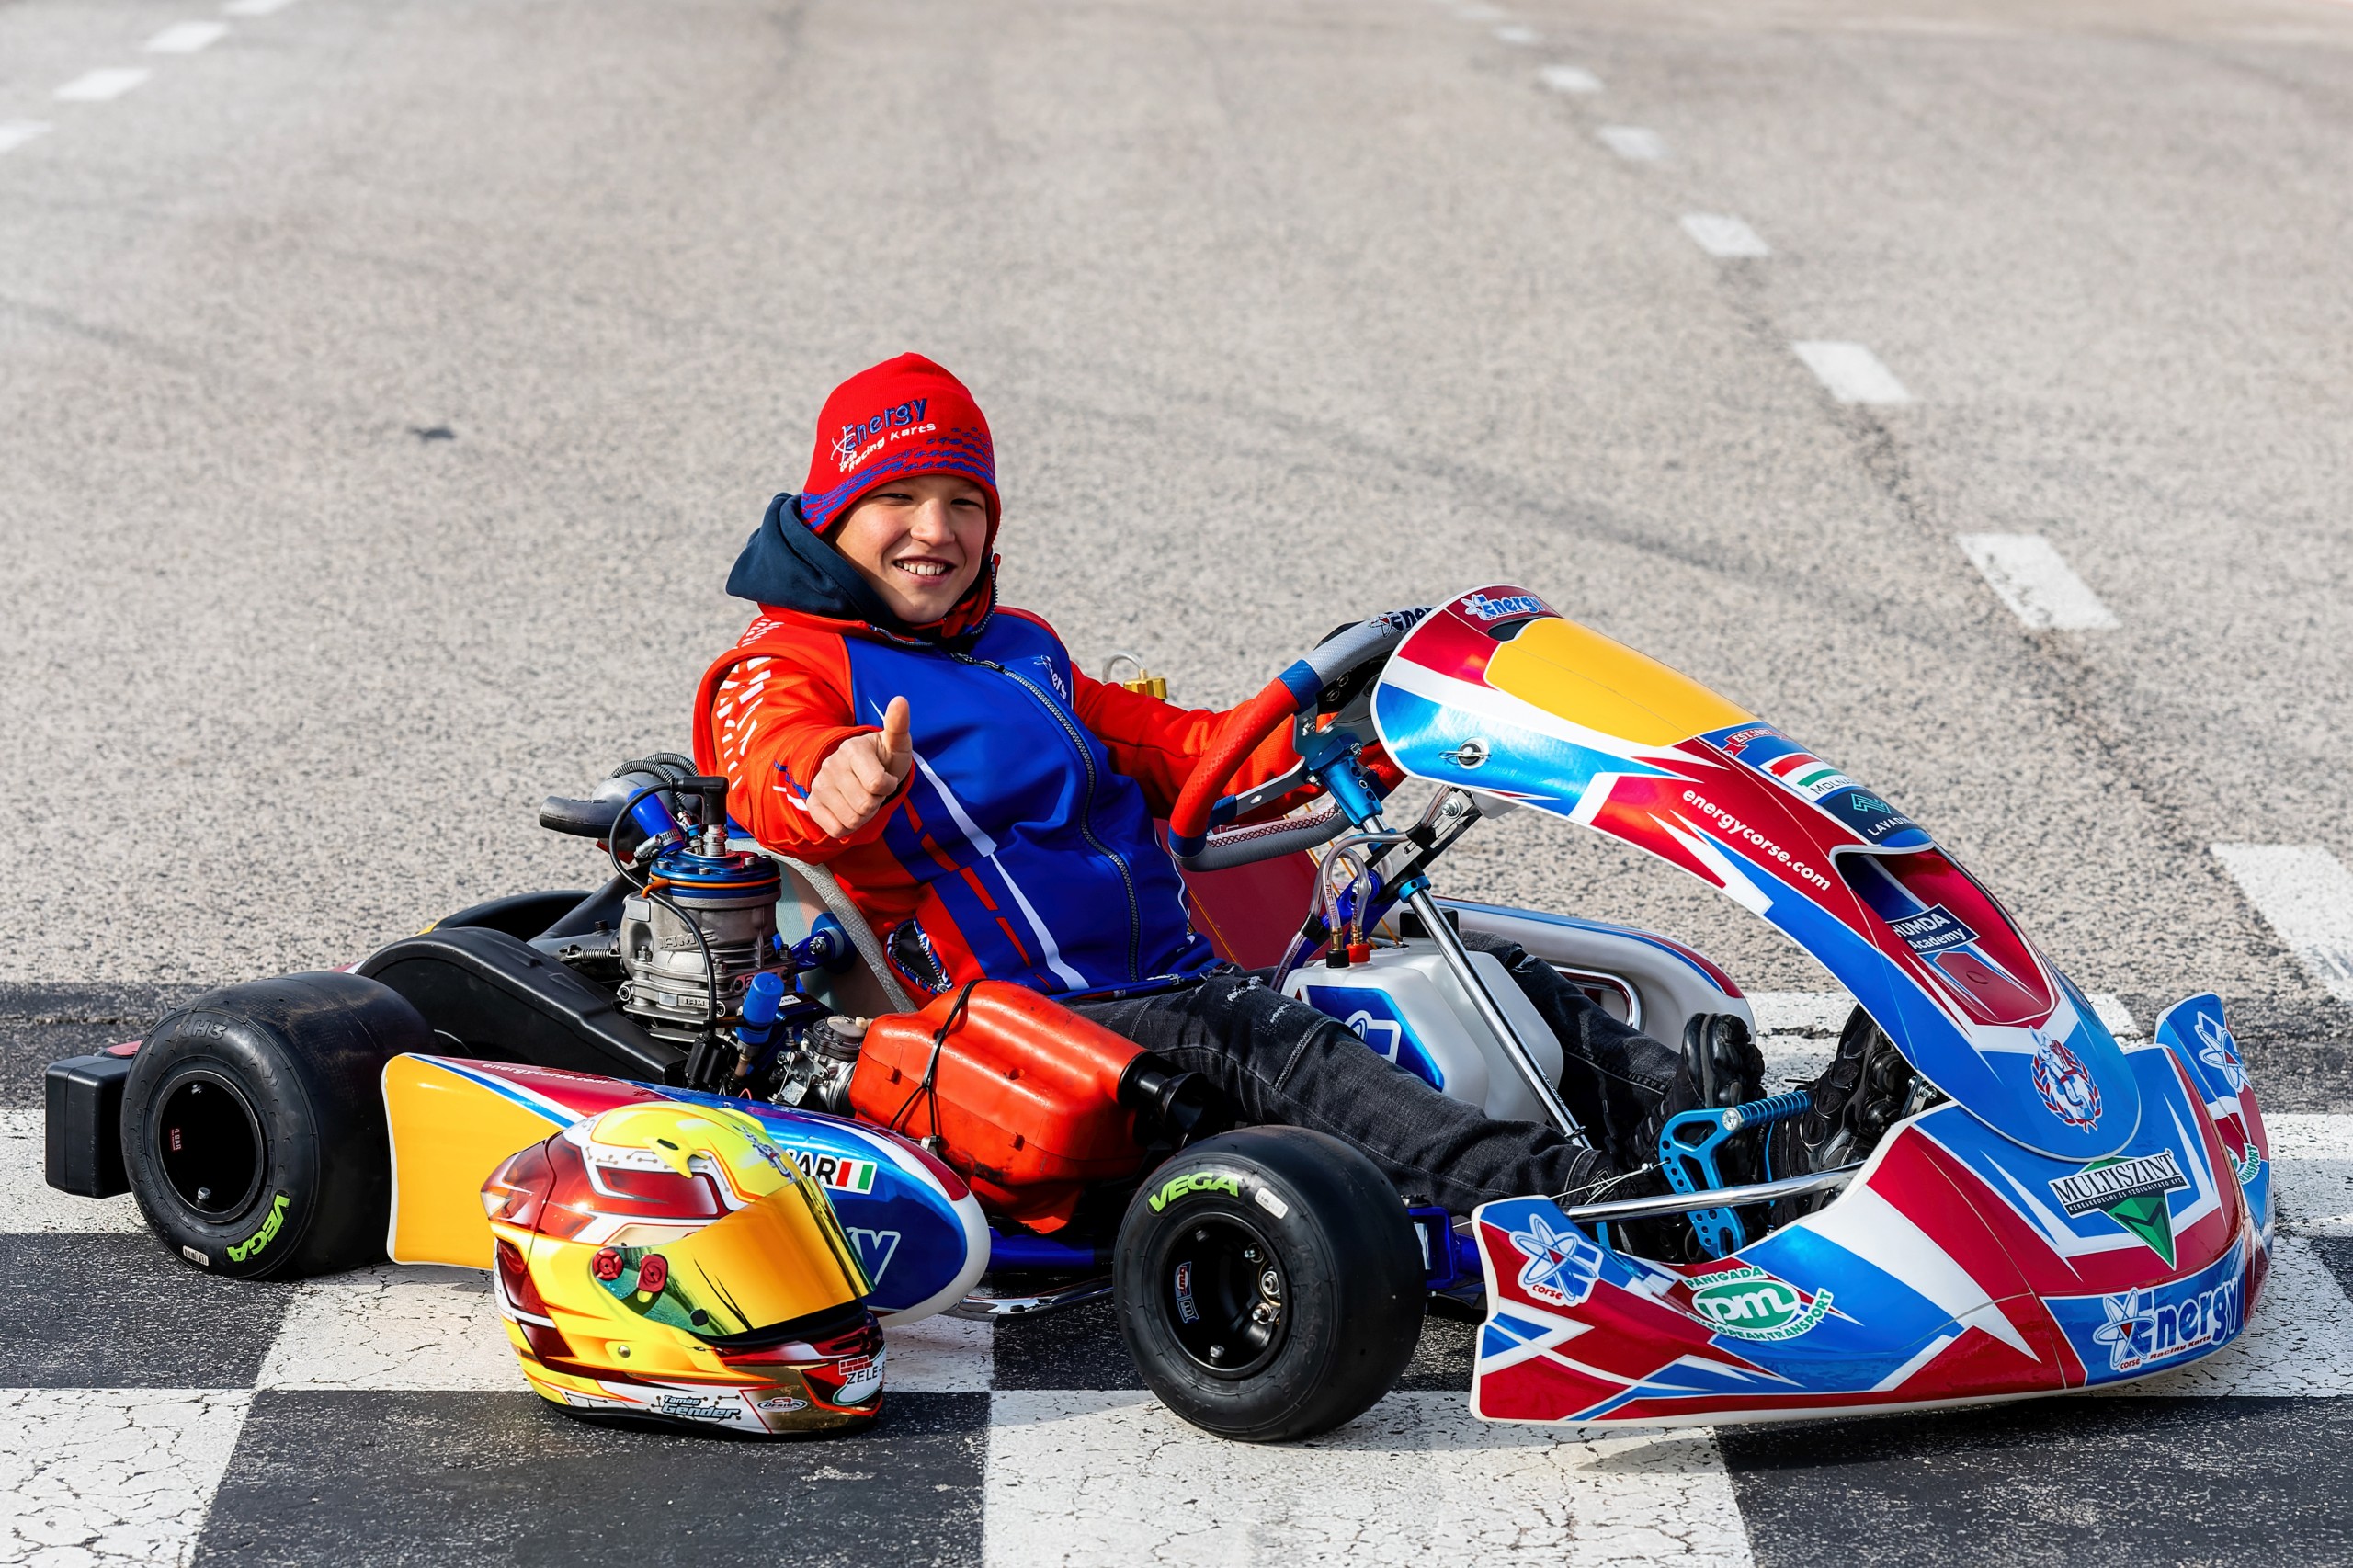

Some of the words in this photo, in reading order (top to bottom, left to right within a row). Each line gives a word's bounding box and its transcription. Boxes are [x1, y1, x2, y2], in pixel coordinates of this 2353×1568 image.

[843, 398, 927, 451] Energy
[848, 437, 885, 472] Racing
[890, 423, 936, 441] Karts
[1476, 595, 1545, 618] Energy
[1682, 790, 1832, 892] energycorse.com
[1891, 913, 1952, 937] HUMDA
[1907, 928, 1967, 950] Academy
[482, 1062, 610, 1085] energycorse.com
[2241, 1144, 2259, 1184] RANSPORT
[2051, 1153, 2180, 1205] MULTISZINT
[1149, 1171, 1244, 1213] VEGA
[2069, 1195, 2117, 1211] KERESKEDELMI
[227, 1194, 290, 1263] VEGA
[1685, 1267, 1765, 1288] PANIGADA
[1532, 1284, 1563, 1300] corse
[1767, 1290, 1832, 1340] TRANSPORT
[2125, 1278, 2239, 1358] Energy
[2150, 1344, 2187, 1359] Racing
[2188, 1335, 2211, 1348] Karts
[2120, 1358, 2141, 1369] corse
[662, 1403, 741, 1419] Gender
